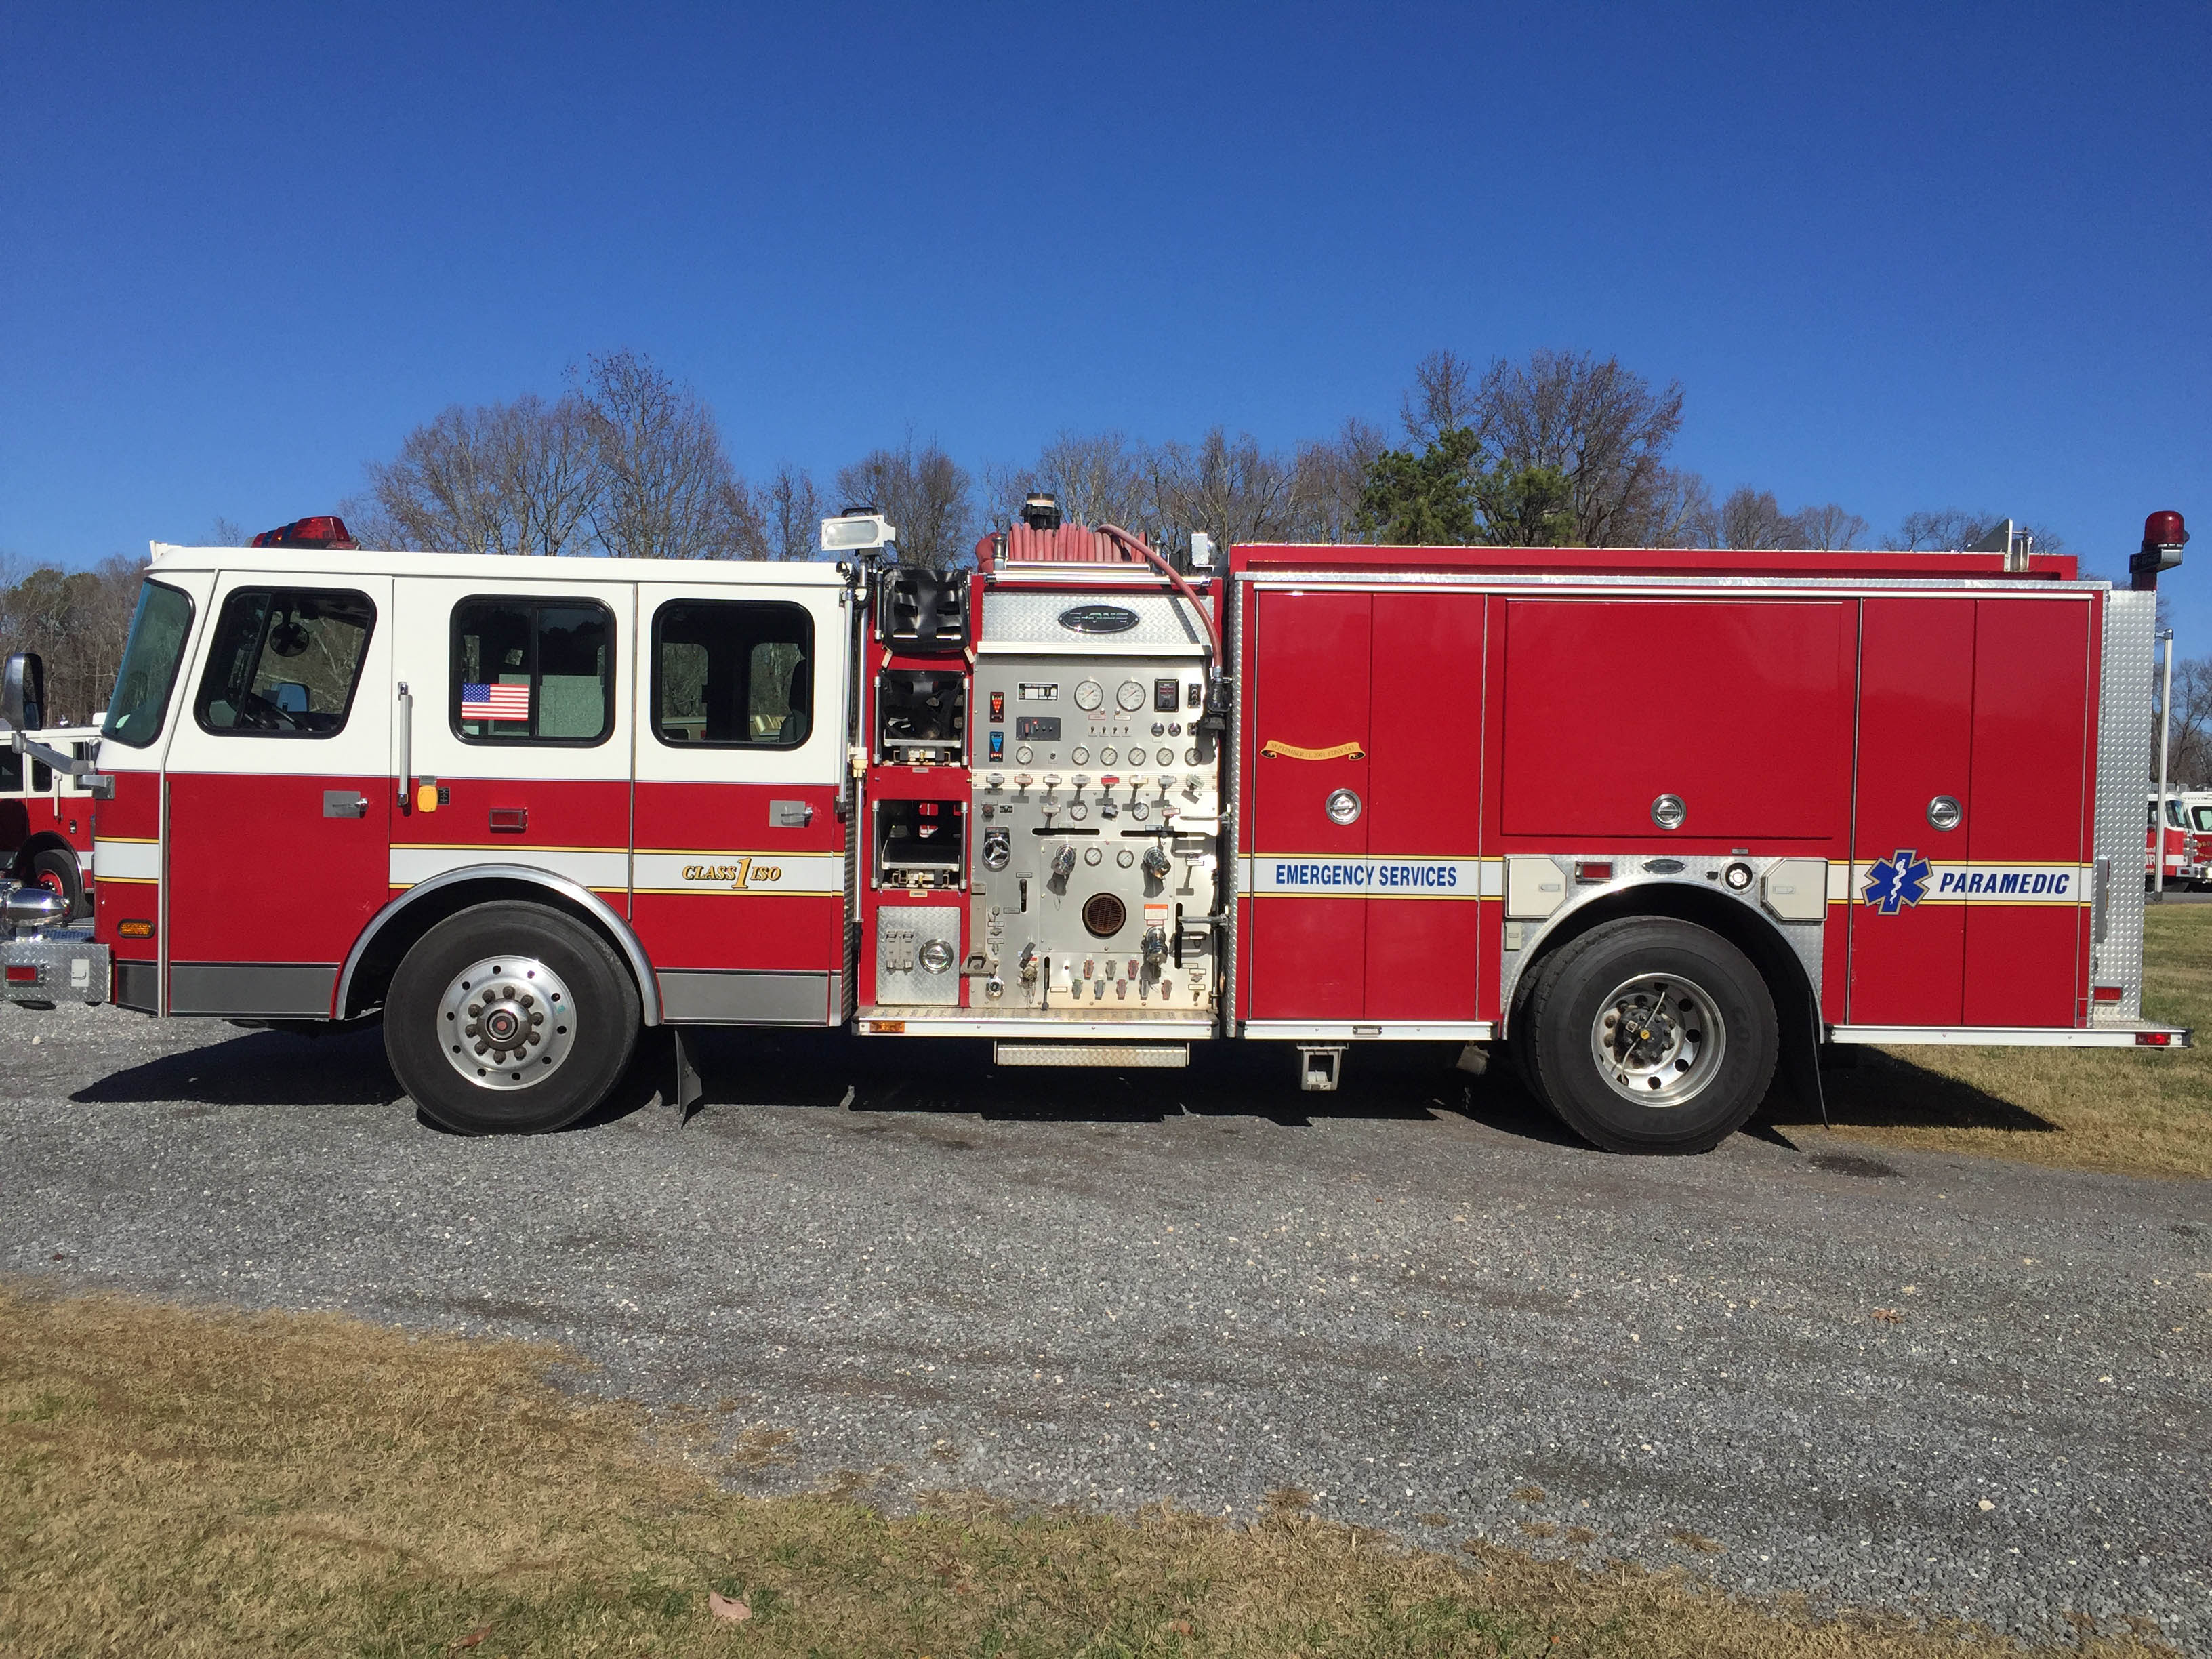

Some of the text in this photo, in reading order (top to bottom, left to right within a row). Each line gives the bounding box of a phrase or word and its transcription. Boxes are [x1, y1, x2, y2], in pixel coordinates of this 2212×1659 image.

[682, 857, 782, 889] CLASS 1 ISO
[1276, 865, 1457, 887] EMERGENCY SERVICES
[1939, 872, 2070, 895] PARAMEDIC
